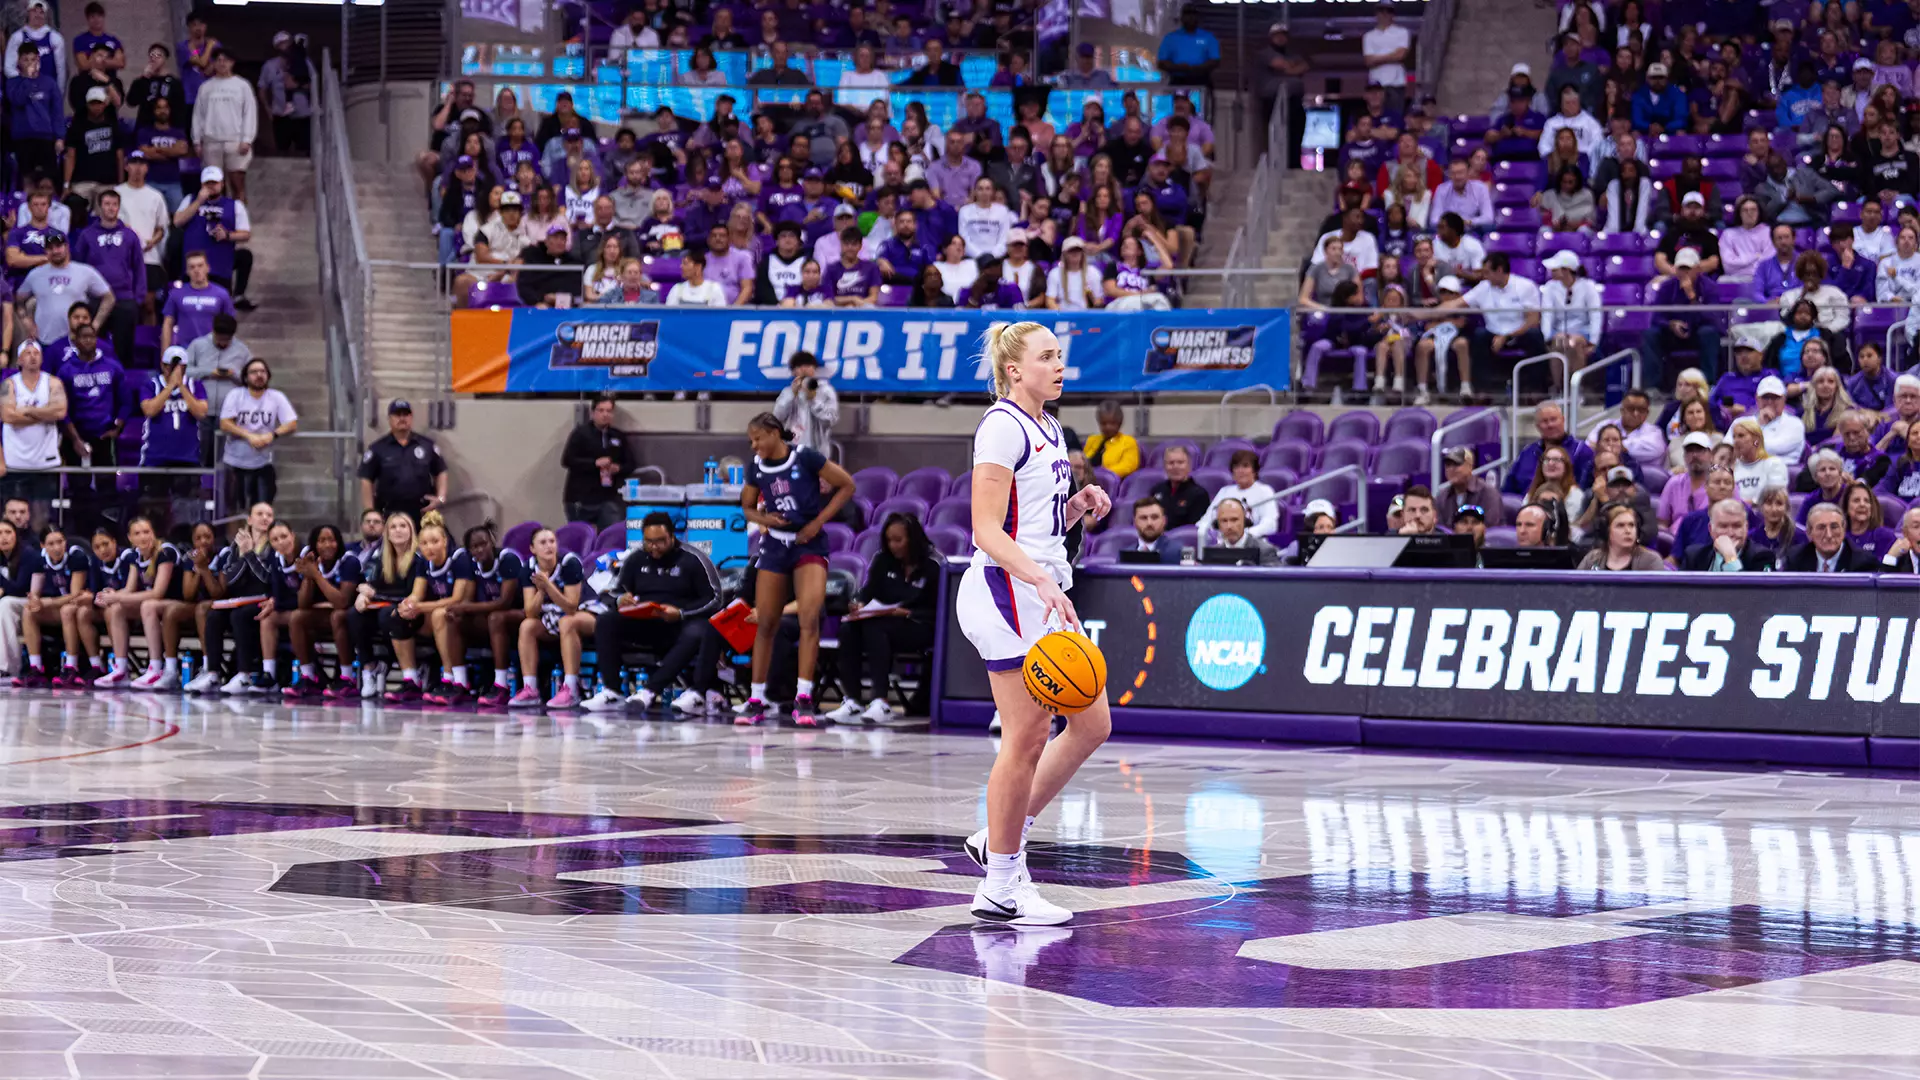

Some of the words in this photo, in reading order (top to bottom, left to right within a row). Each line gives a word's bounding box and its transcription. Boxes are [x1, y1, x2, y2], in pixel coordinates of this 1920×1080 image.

[575, 325, 631, 341] MARCH
[1169, 330, 1228, 348] MARCH
[582, 341, 655, 359] MADNESS
[724, 320, 883, 379] FOUR
[898, 321, 969, 380] IT
[1176, 347, 1252, 364] MADNESS
[238, 411, 273, 426] TCU
[1192, 639, 1261, 666] NCAA
[1303, 606, 1735, 697] CELEBRATES
[1030, 661, 1064, 696] NCAA
